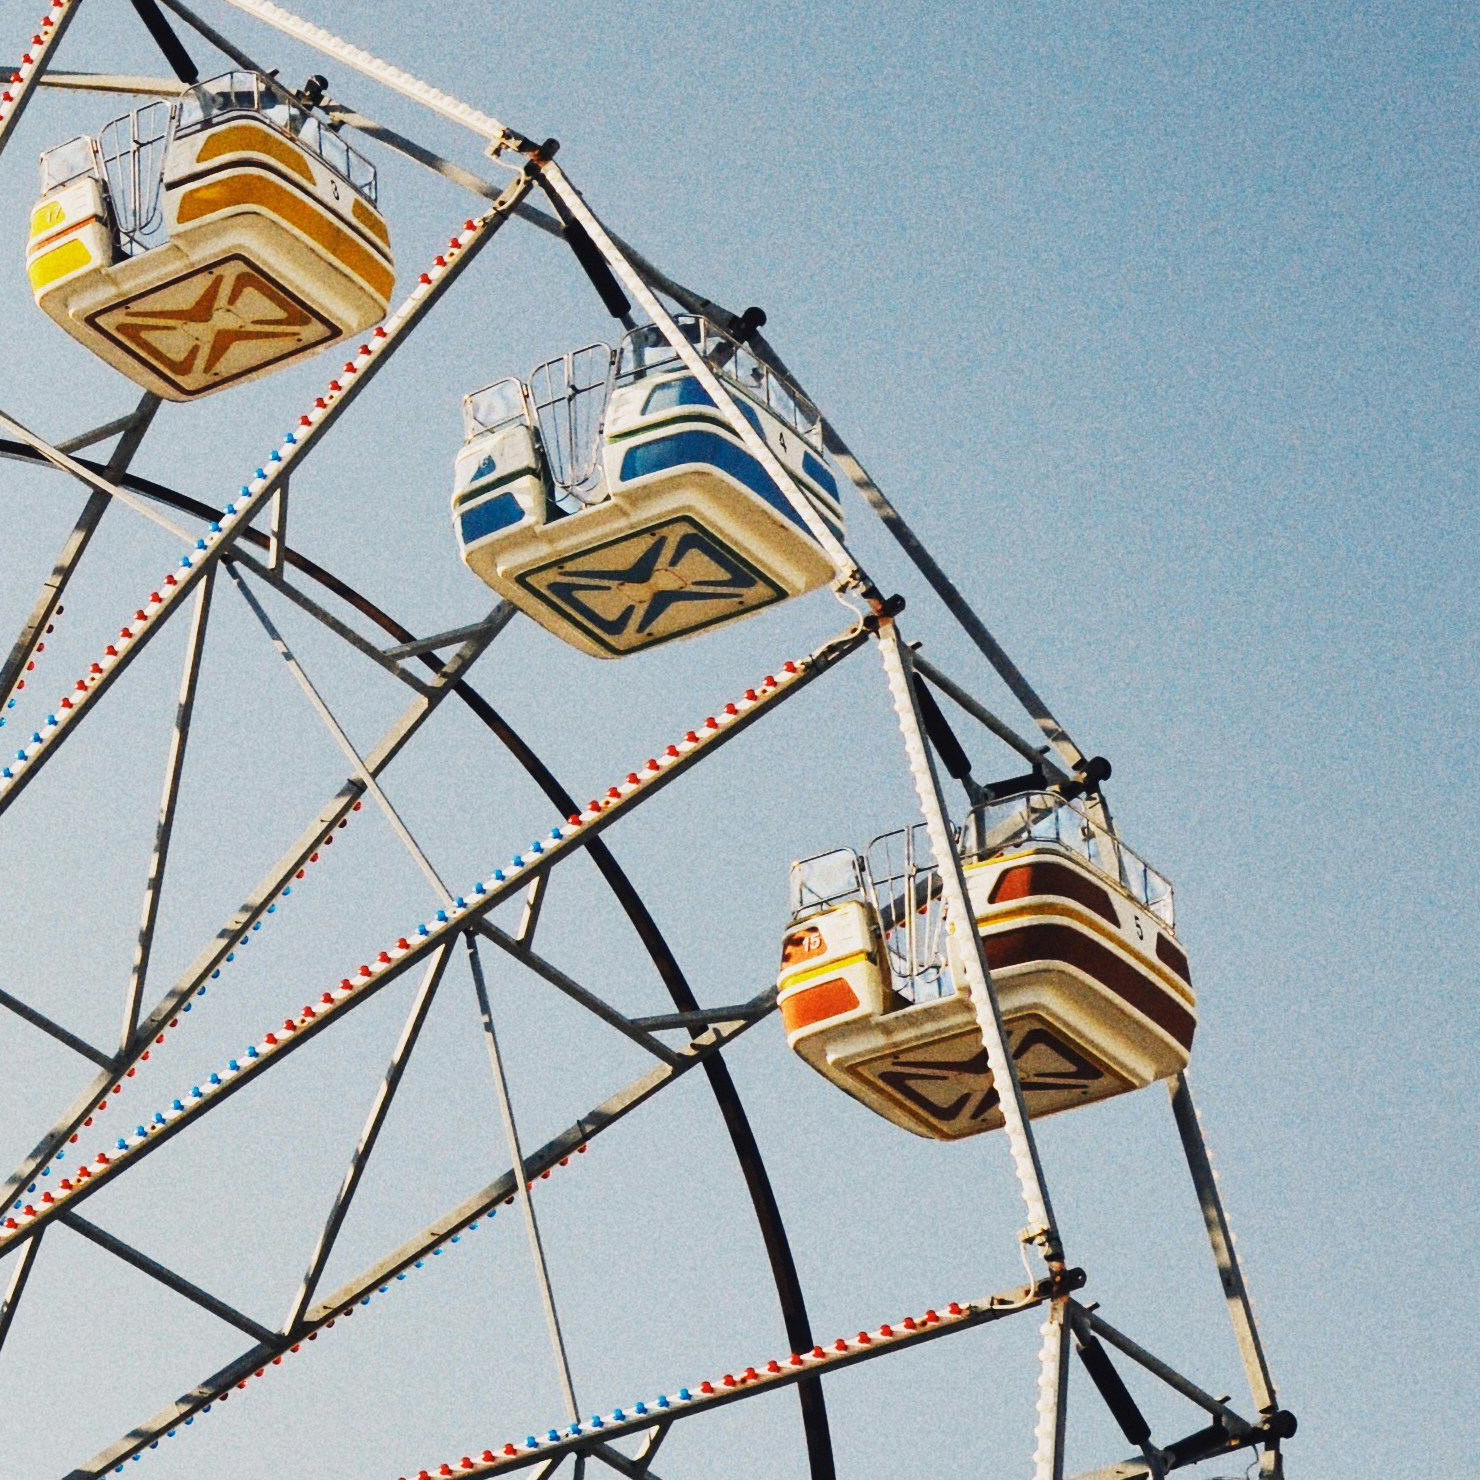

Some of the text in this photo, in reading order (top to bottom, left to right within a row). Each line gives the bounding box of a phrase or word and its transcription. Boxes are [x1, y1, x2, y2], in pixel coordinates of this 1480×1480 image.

[330, 179, 340, 201] 3
[778, 431, 787, 453] 4
[1133, 914, 1144, 941] 5
[802, 932, 821, 952] 15
